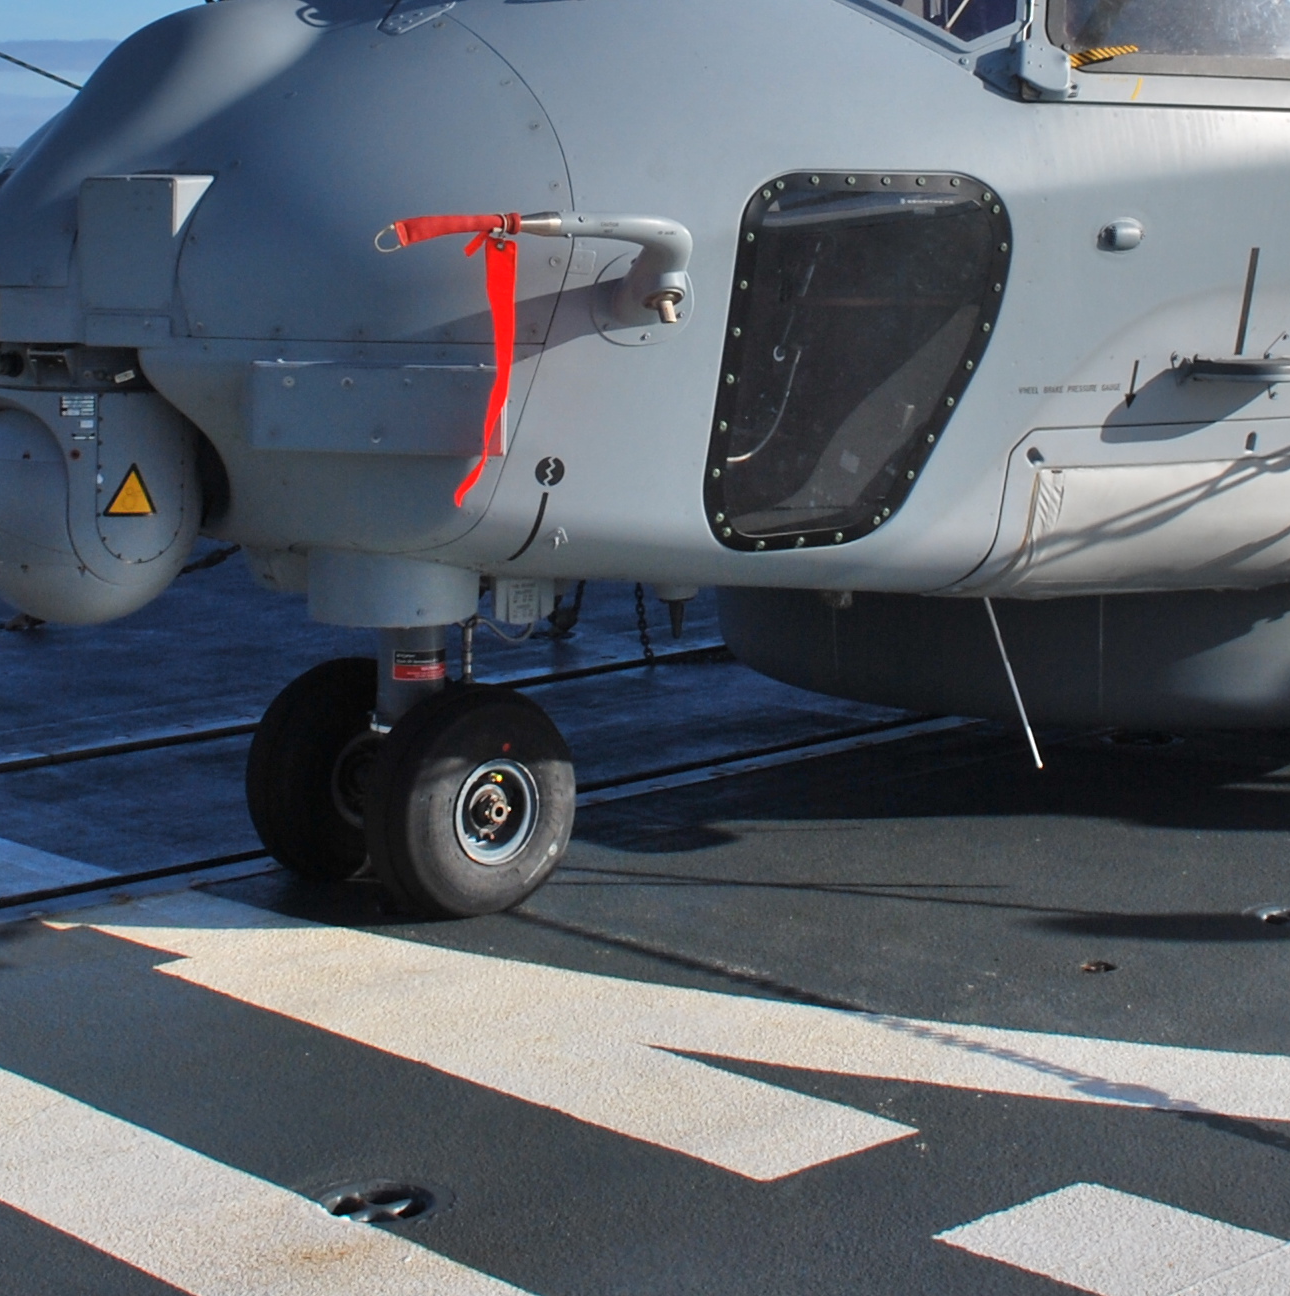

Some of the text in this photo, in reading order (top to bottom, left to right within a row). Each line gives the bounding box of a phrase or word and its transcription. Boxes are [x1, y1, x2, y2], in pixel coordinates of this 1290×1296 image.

[1018, 383, 1121, 395] WHEEL BRAKE PRESSURE GAUGE
